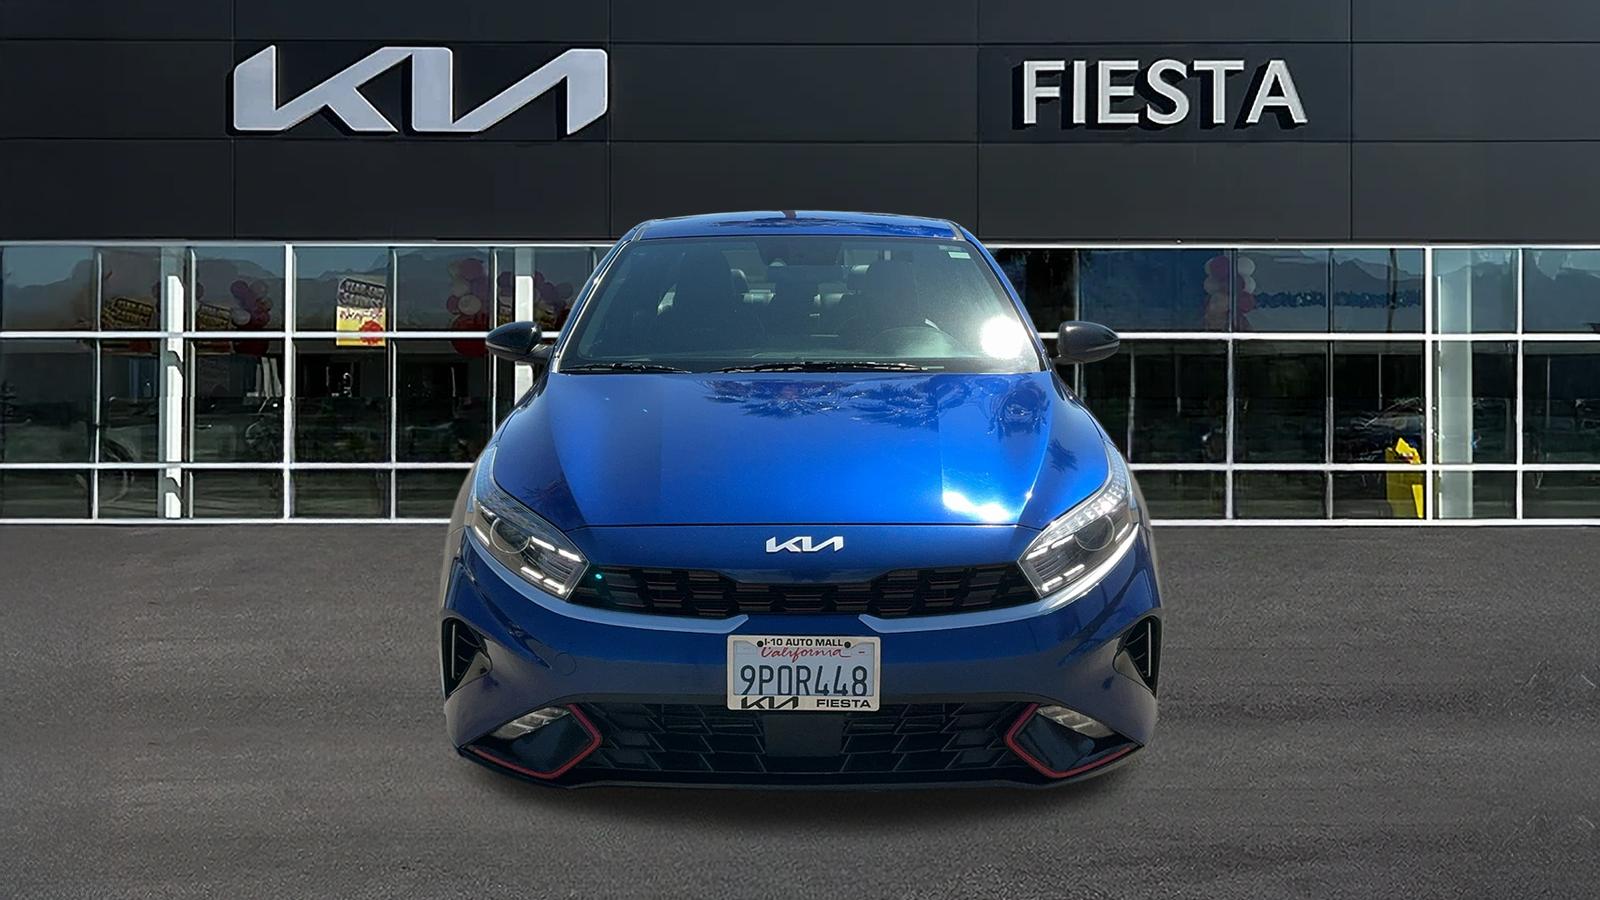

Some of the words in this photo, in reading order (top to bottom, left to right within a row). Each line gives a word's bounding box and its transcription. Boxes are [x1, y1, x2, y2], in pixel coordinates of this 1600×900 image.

[233, 45, 608, 135] KIA
[1023, 59, 1308, 125] FIESTA
[765, 536, 844, 552] KIA
[764, 638, 783, 646] I-10
[785, 638, 813, 647] AUTO
[815, 639, 843, 647] MALL
[761, 647, 851, 663] California
[741, 696, 799, 709] KIA
[816, 699, 871, 708] FIESTA
